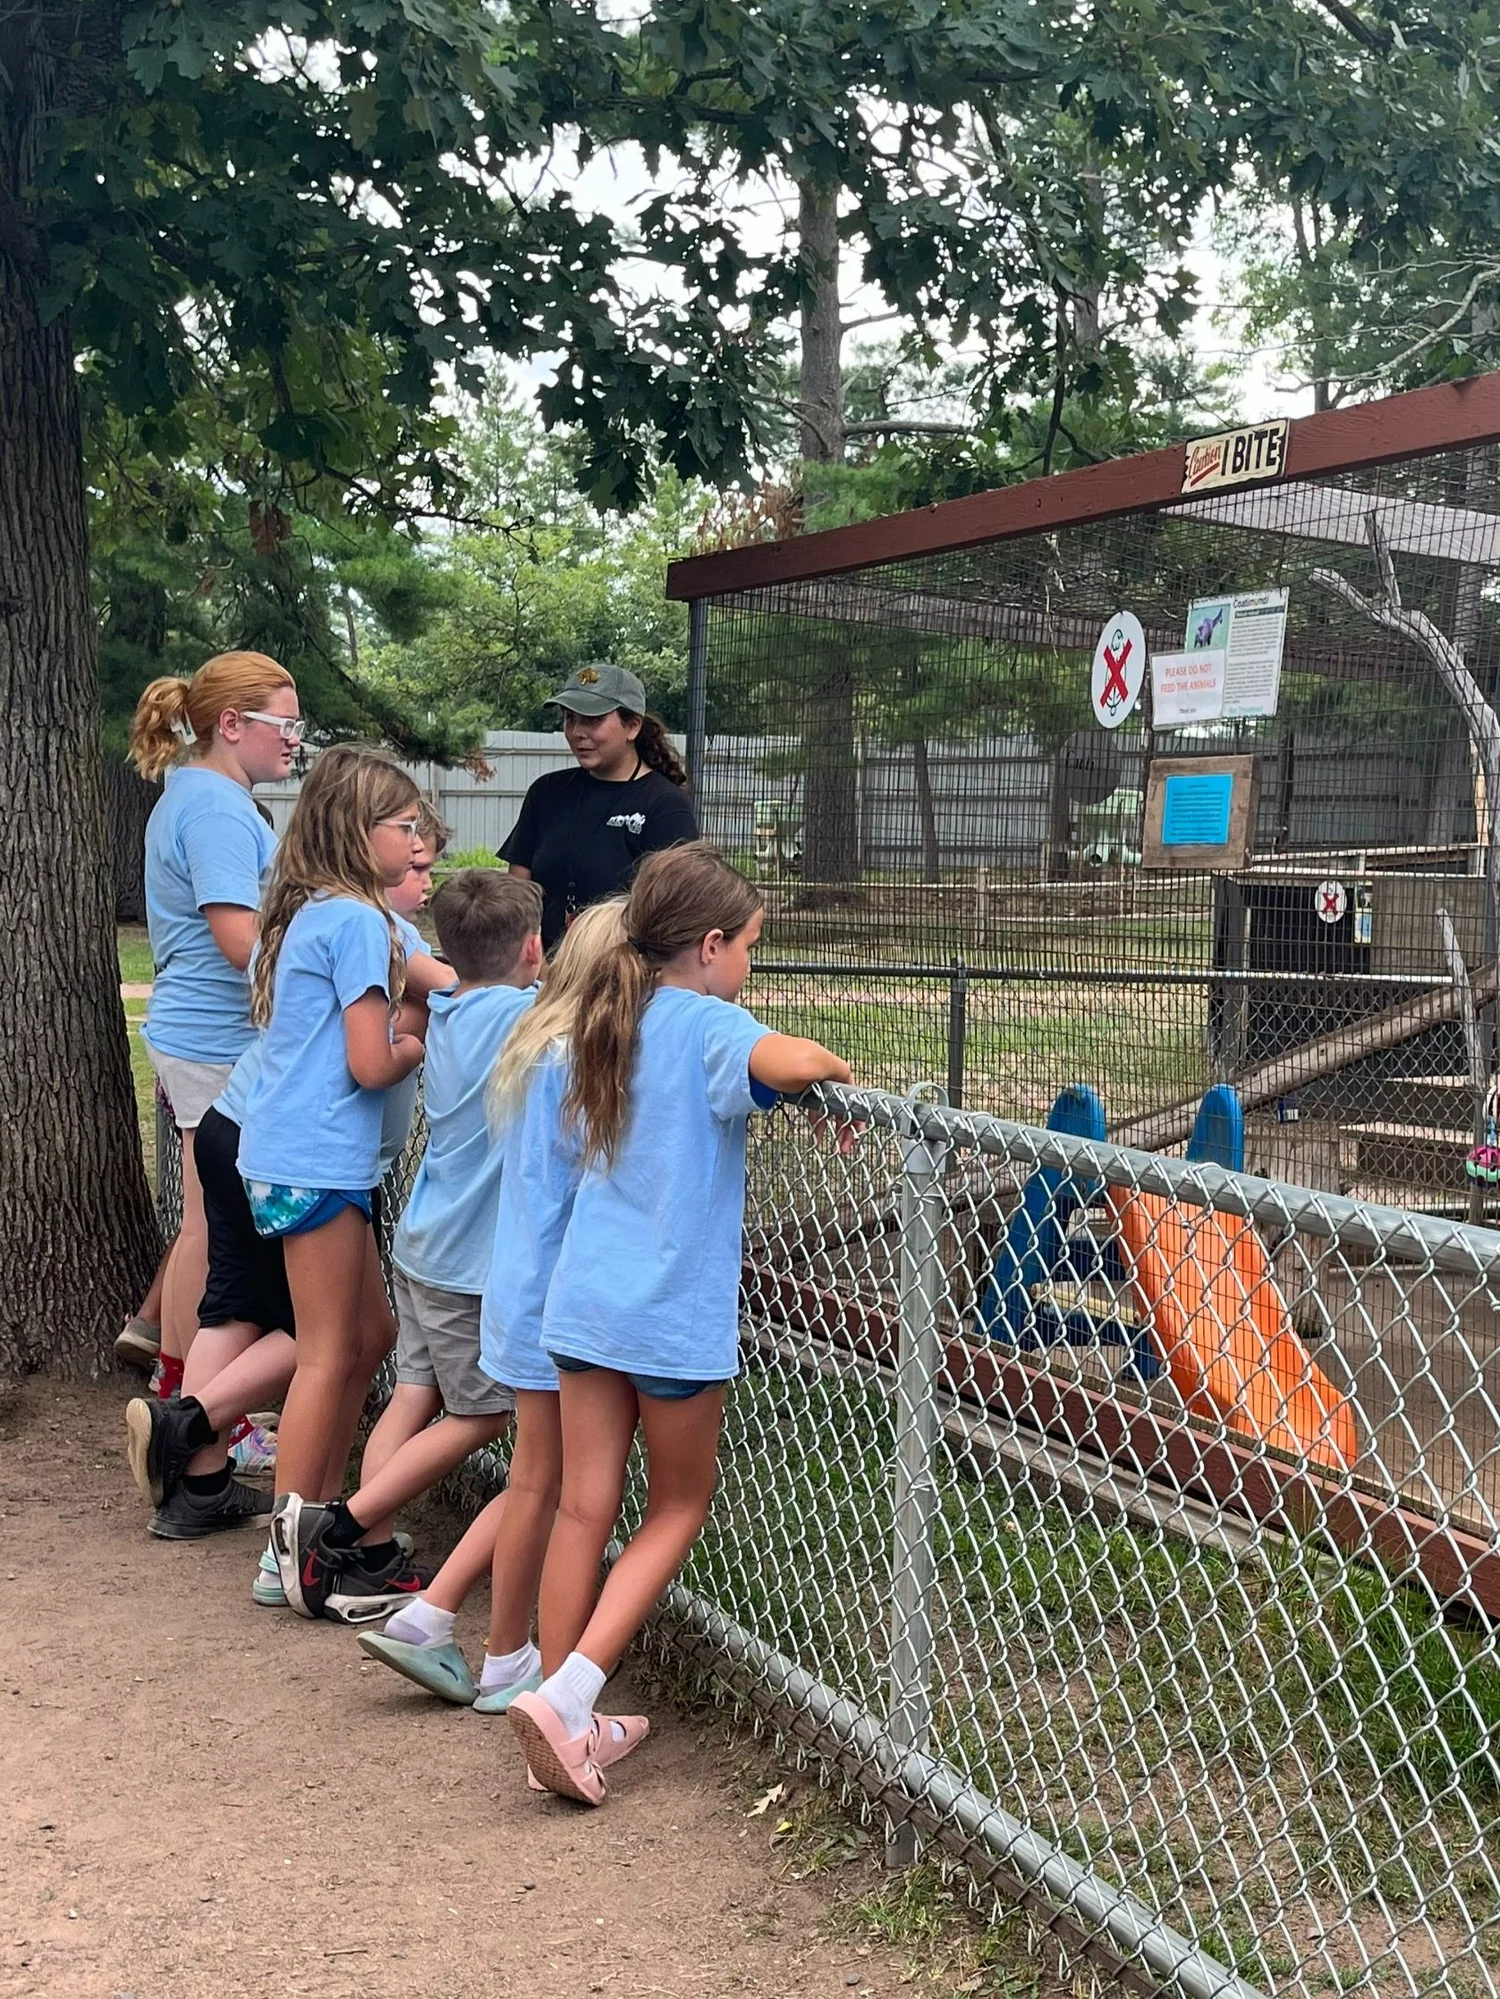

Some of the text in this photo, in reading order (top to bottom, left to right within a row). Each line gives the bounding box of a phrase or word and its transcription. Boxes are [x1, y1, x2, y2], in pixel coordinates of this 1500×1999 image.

[1189, 428, 1280, 479] Caution I BITE
[1165, 663, 1212, 677] PLEASE DO NOT
[1160, 678, 1217, 693] FEED THE ANIMALS
